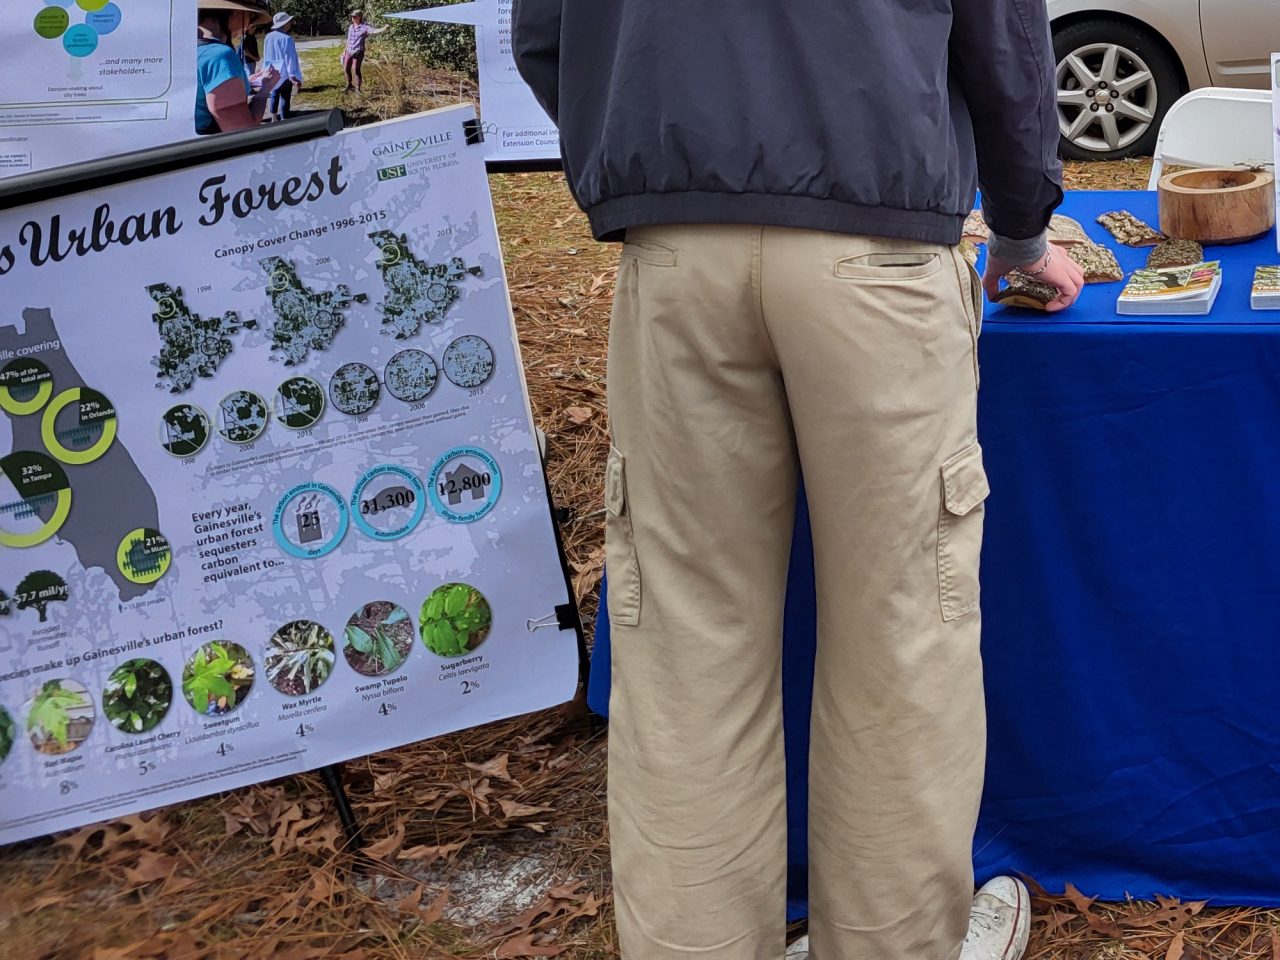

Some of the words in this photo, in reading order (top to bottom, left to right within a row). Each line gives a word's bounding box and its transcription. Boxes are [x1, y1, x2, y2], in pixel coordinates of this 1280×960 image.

[502, 130, 513, 138] For
[514, 129, 548, 138] additional
[502, 139, 535, 148] Extension
[535, 138, 559, 147] Counci
[380, 165, 405, 180] USF
[19, 203, 183, 267] Urban
[199, 155, 348, 227] Forest
[214, 243, 255, 259] Canopy
[257, 235, 287, 249] Cover
[288, 224, 328, 242] Change
[330, 210, 388, 232] 1996-2015
[16, 340, 60, 357] covering
[80, 401, 100, 413] 22%
[408, 402, 426, 413] 2006
[468, 387, 485, 399] 2015
[88, 408, 115, 419] Orlando
[239, 443, 256, 453] 2006
[296, 430, 313, 440] 2015
[21, 463, 43, 476] 32%
[30, 472, 53, 484] Tampa
[438, 471, 492, 497] 12,800
[361, 489, 416, 516] 31,300
[191, 508, 222, 522] Every
[225, 502, 251, 517] year,
[301, 512, 320, 529] 25
[194, 510, 262, 534] Gainesville's
[145, 536, 166, 547] 21%
[196, 532, 229, 547] urban
[230, 522, 264, 539] forest
[199, 538, 257, 559] sequesters
[201, 555, 239, 571] carbon
[203, 561, 261, 583] equivalent
[32, 658, 63, 674] make
[65, 655, 81, 669] up
[82, 635, 151, 663] Gainesville's
[152, 629, 186, 647] urban
[187, 619, 224, 638] forest?
[440, 654, 484, 672] Sugarberry
[354, 681, 382, 695] Swamp
[381, 674, 409, 688] Tupelo
[460, 679, 481, 696] 2%
[281, 701, 297, 712] Wax
[298, 695, 323, 708] Myrtle
[377, 702, 398, 717] 4%
[203, 715, 241, 731] Sweetgum
[295, 722, 315, 739] 4%
[216, 741, 235, 757] 4%
